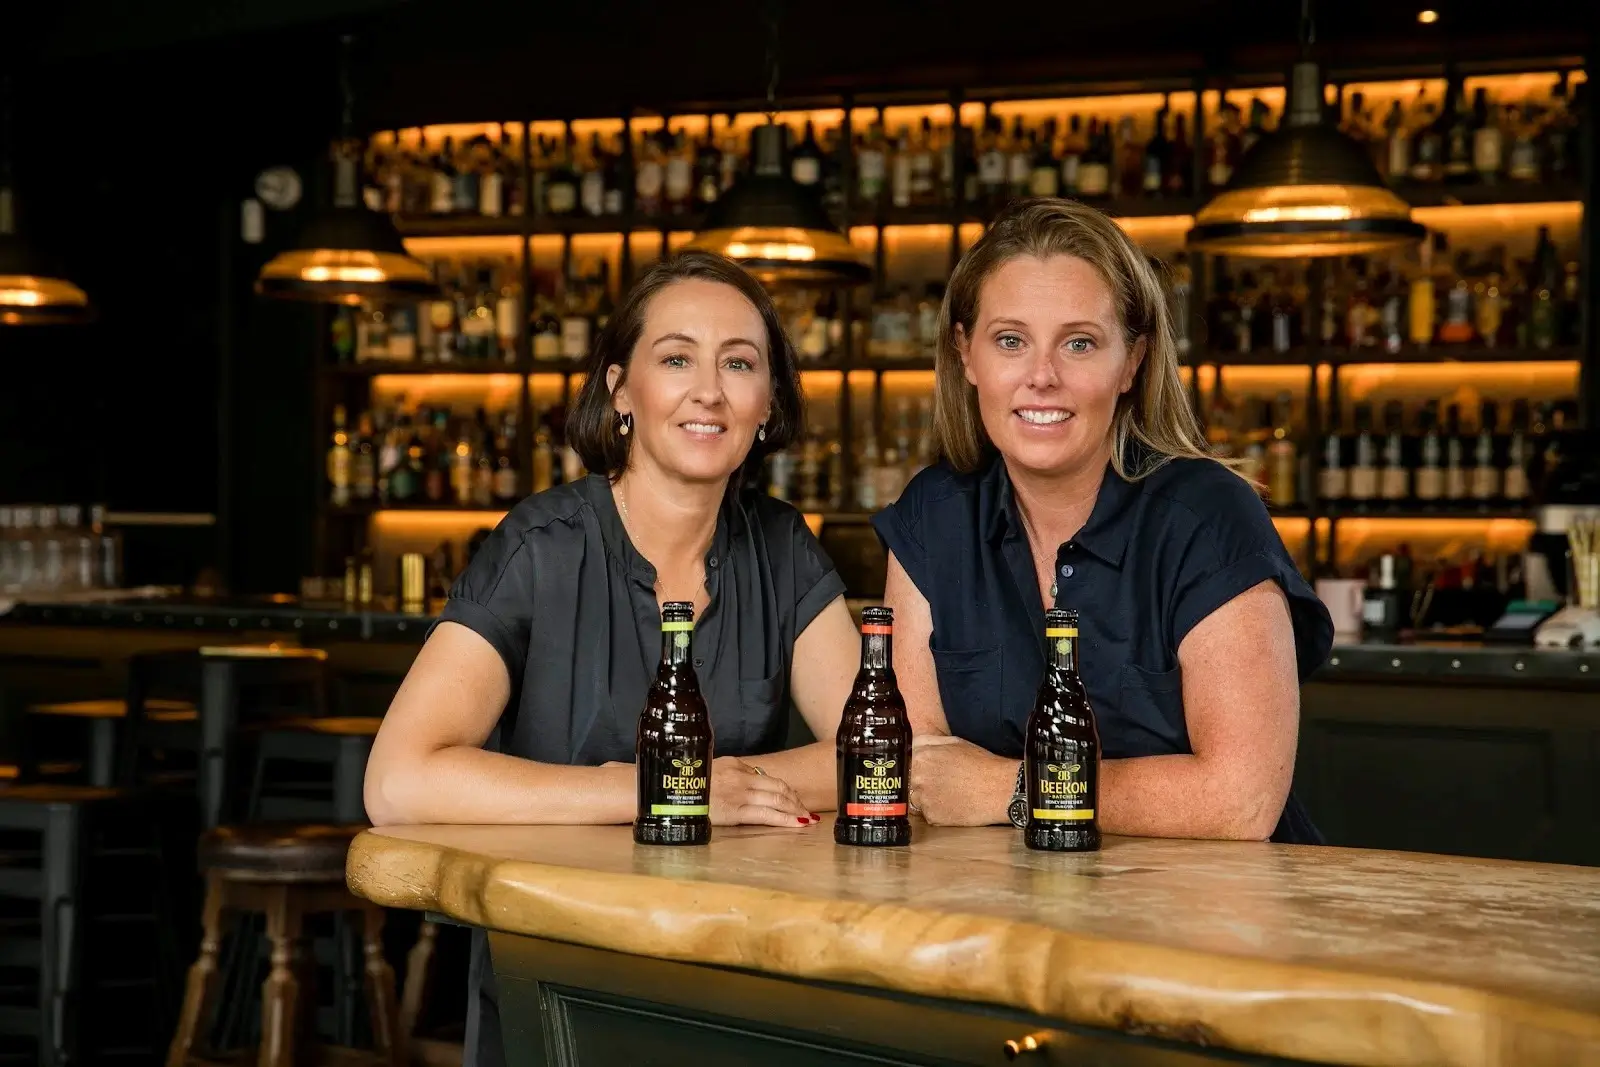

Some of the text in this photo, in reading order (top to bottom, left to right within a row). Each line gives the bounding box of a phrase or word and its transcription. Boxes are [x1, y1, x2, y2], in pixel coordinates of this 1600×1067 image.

[662, 774, 707, 790] BEEKON
[855, 774, 902, 790] BEEKON
[1040, 779, 1088, 794] BEEKON
